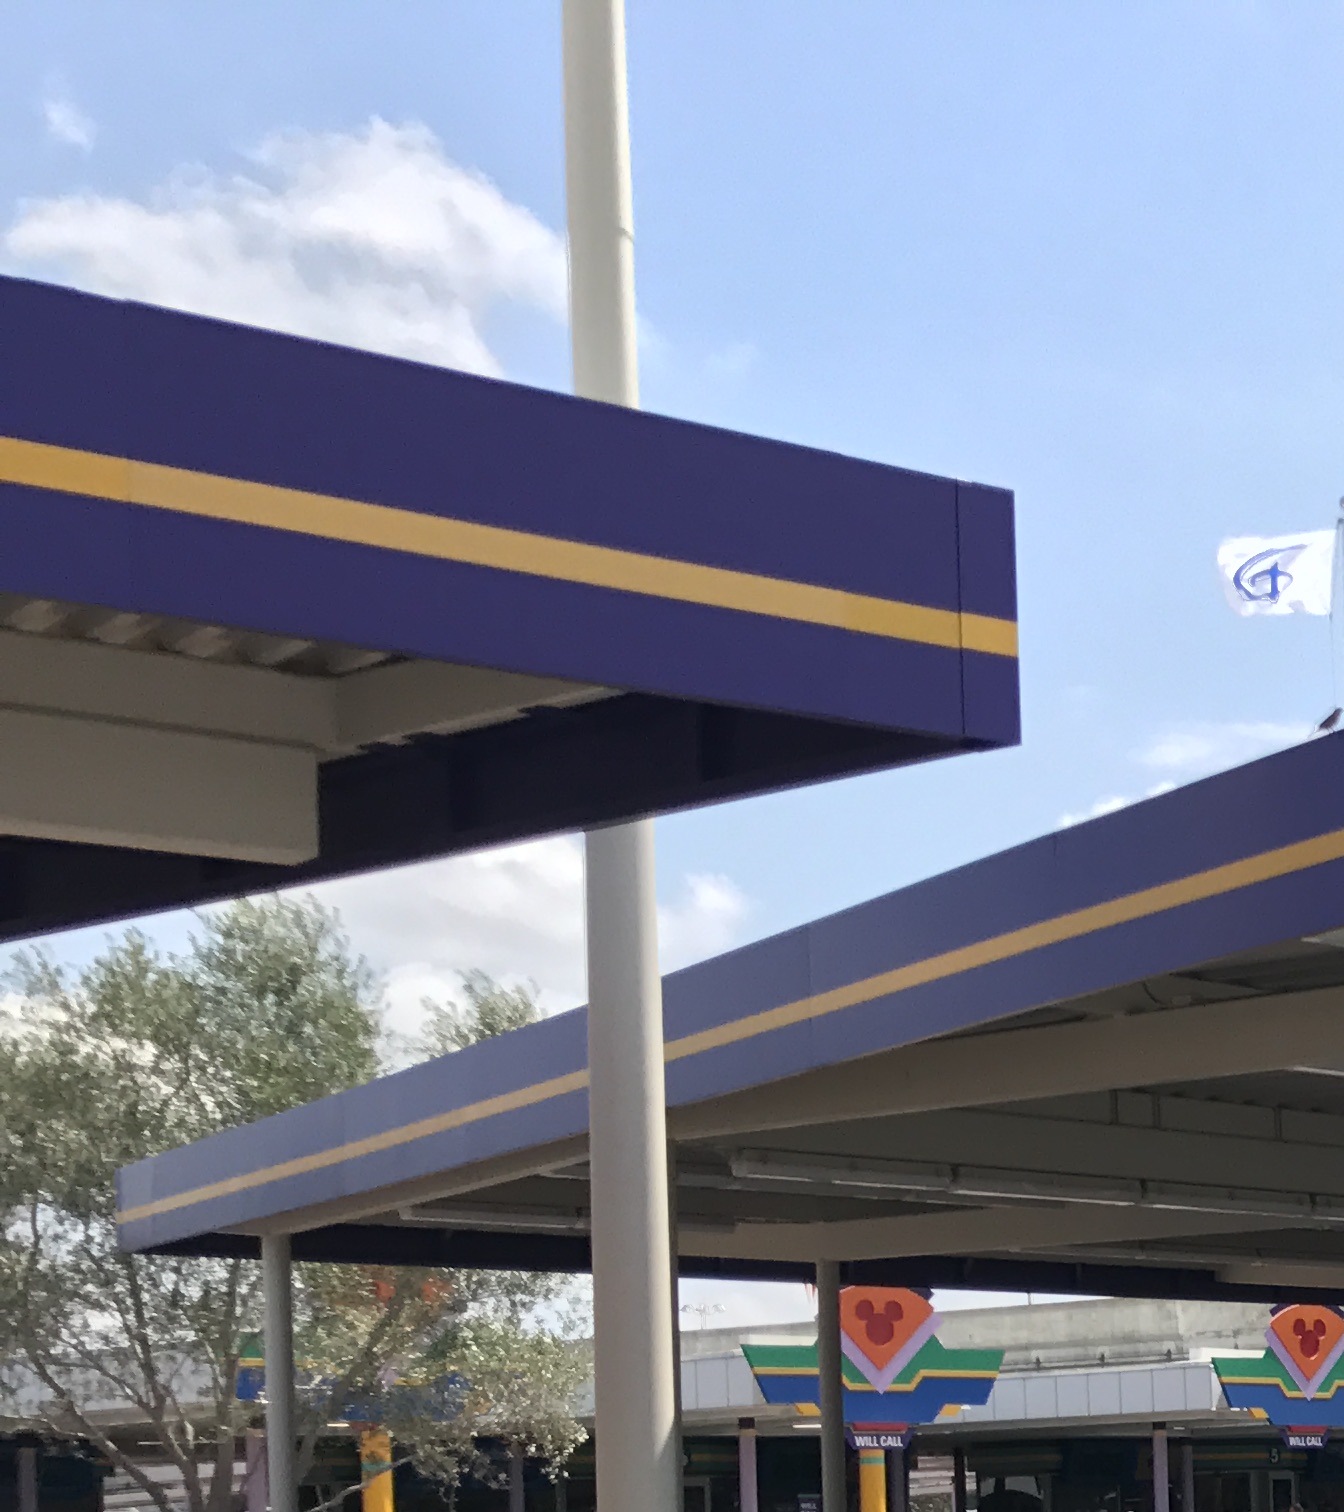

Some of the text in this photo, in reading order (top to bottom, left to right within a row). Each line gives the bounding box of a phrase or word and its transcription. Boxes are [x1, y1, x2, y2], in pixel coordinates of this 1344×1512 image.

[854, 1435, 904, 1447] WILL CALL
[1288, 1436, 1323, 1447] WILL CALL
[1270, 1448, 1279, 1464] 5
